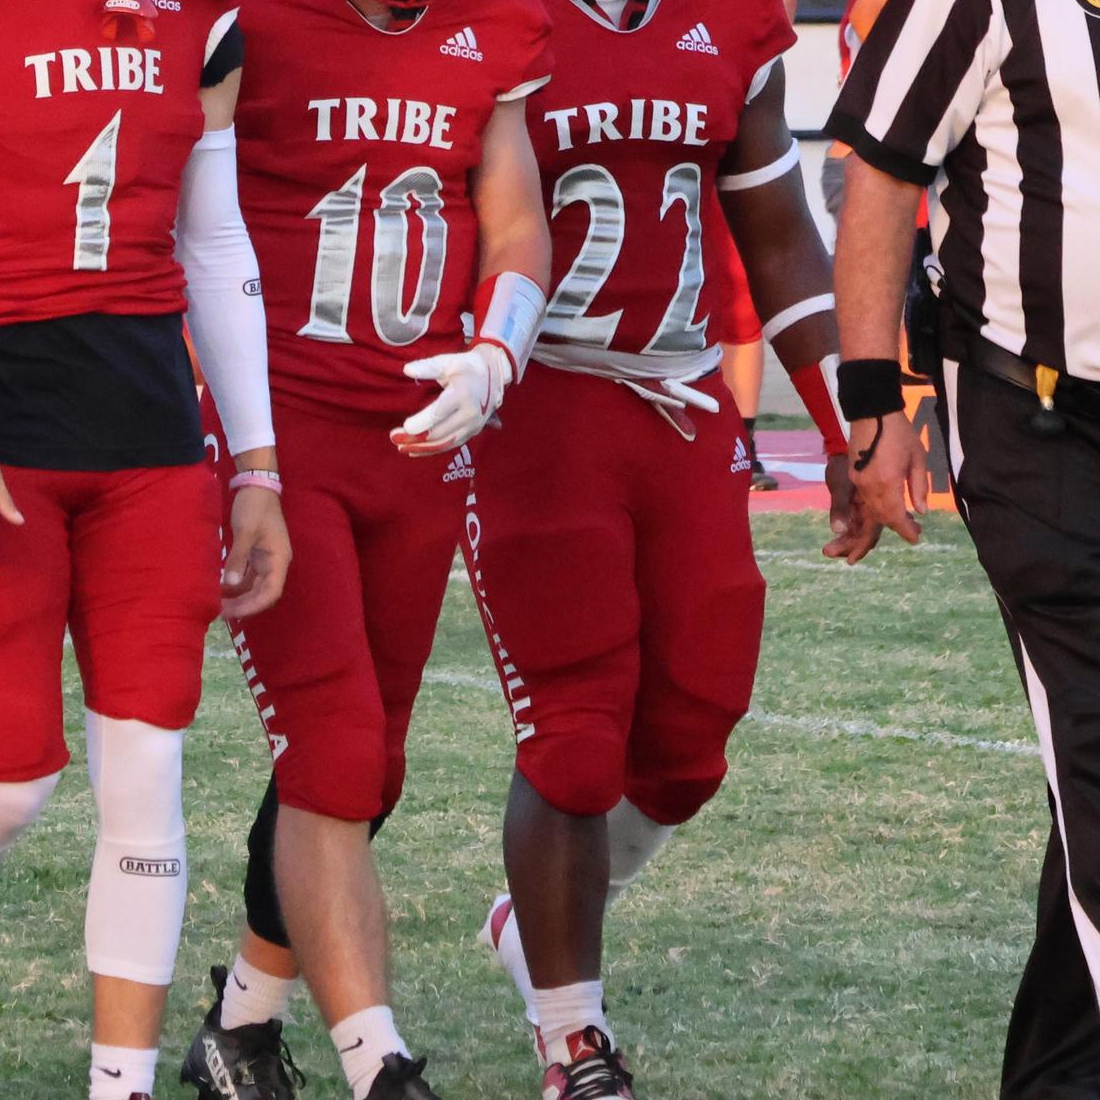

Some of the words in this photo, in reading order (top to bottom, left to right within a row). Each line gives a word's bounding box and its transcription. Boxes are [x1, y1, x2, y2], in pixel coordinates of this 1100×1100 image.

[24, 46, 164, 99] TRIBE
[439, 43, 483, 63] adidas
[676, 39, 719, 56] adidas
[307, 97, 457, 150] TRIBE
[544, 98, 710, 151] TRIBE
[63, 108, 122, 271] 1
[297, 163, 449, 347] 10
[443, 466, 476, 482] adidas
[126, 860, 178, 873] BATTLE
